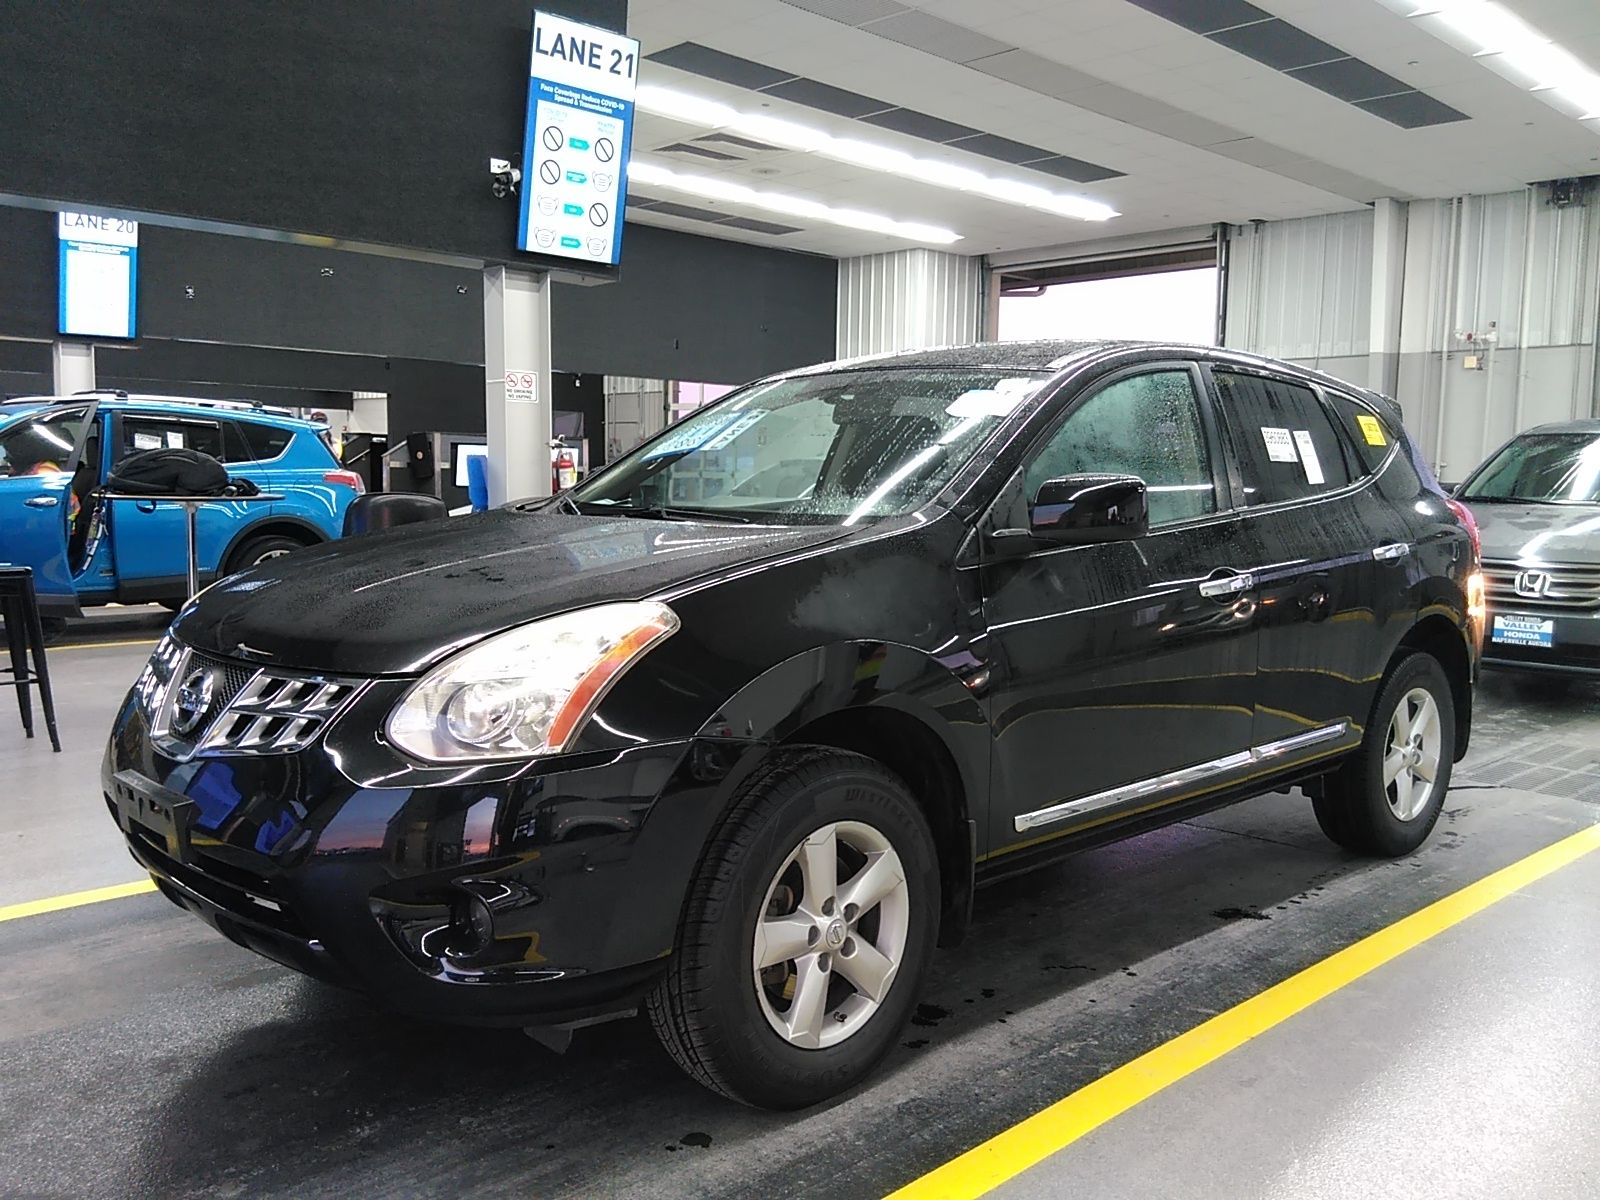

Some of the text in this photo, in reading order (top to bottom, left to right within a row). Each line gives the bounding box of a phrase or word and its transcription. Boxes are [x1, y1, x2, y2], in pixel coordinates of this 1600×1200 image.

[535, 27, 634, 78] LANE 21
[64, 211, 134, 233] LANE 20
[1503, 622, 1543, 630] VALLEY
[1503, 631, 1540, 639] HONDA
